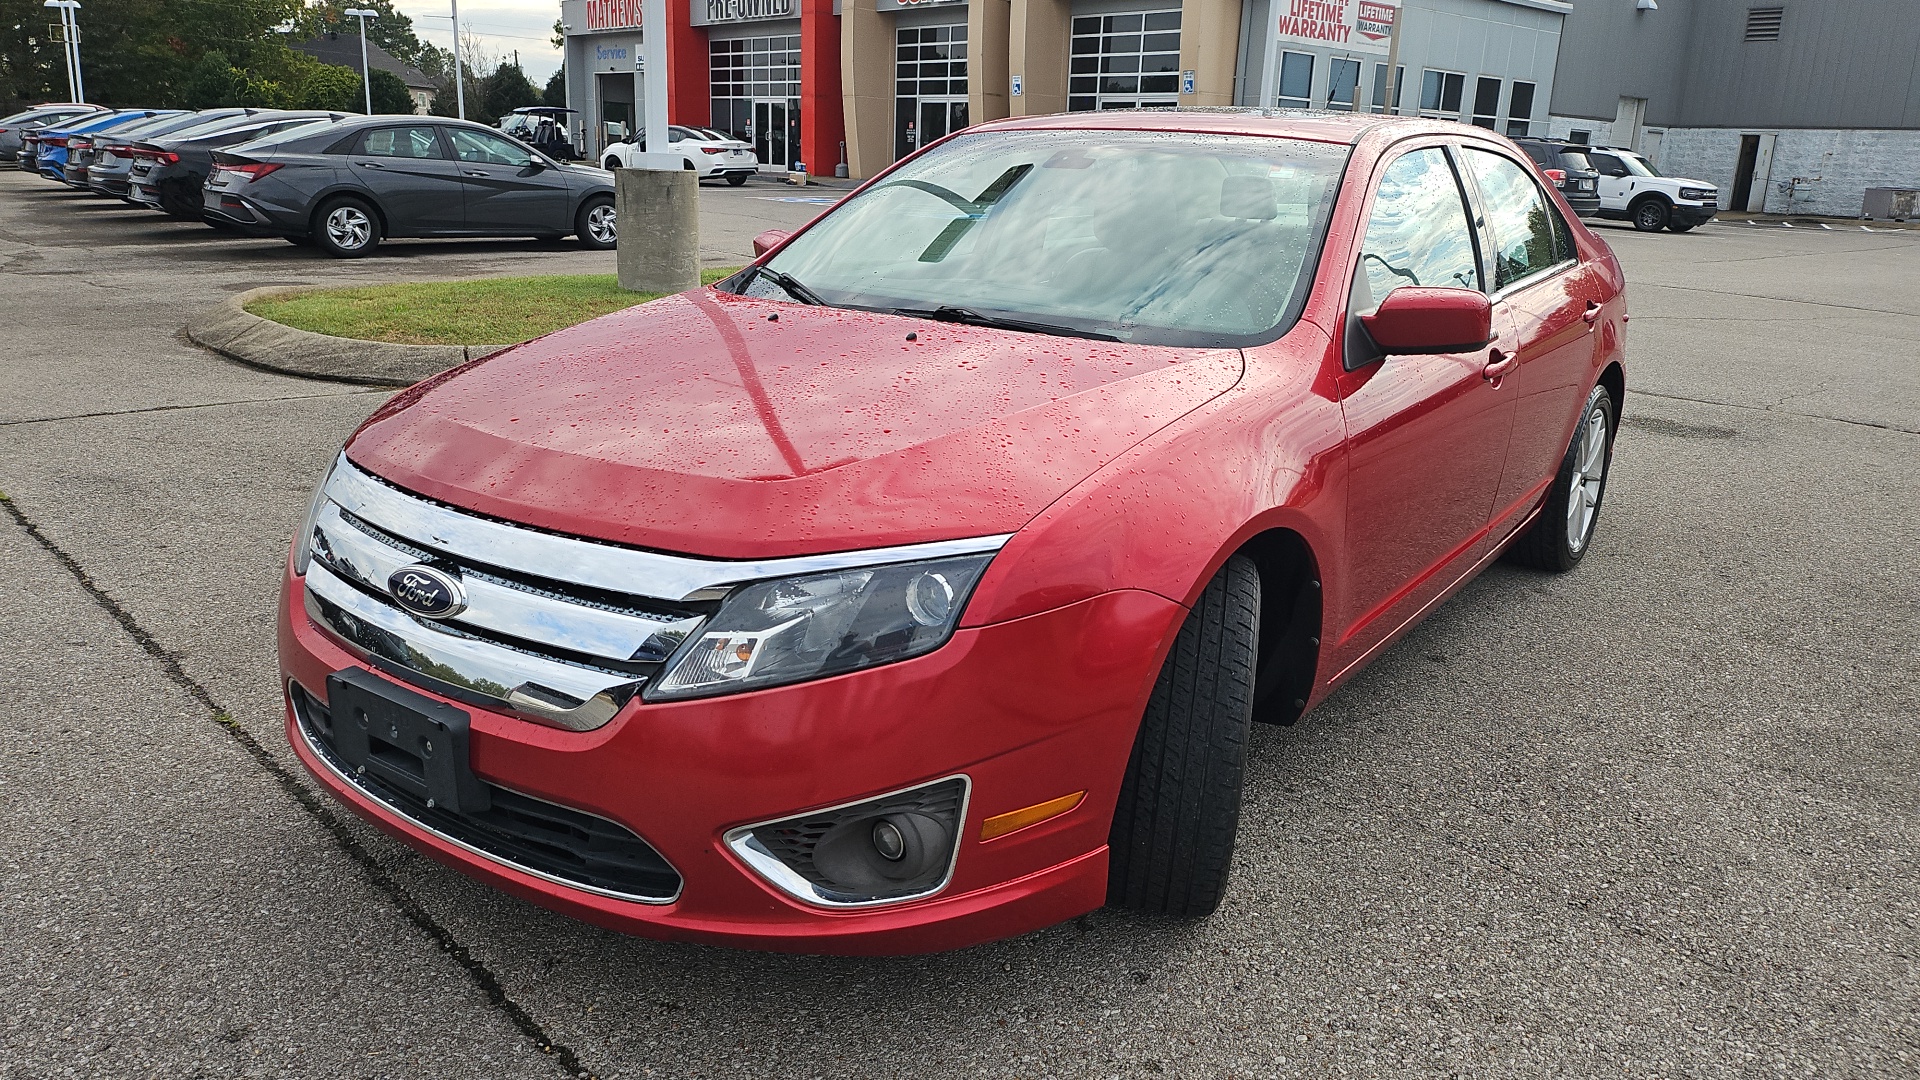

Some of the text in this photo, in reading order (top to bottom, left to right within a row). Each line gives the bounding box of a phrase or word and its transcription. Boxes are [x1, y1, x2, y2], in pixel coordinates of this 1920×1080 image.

[586, 0, 643, 30] MATHEWS
[1290, 0, 1344, 23] LIFETIME
[1359, 4, 1394, 22] LIFETIME
[1279, 15, 1352, 43] WARRANTY
[1357, 20, 1392, 35] WARRANTY
[596, 45, 627, 60] Service
[397, 573, 440, 607] Ford
